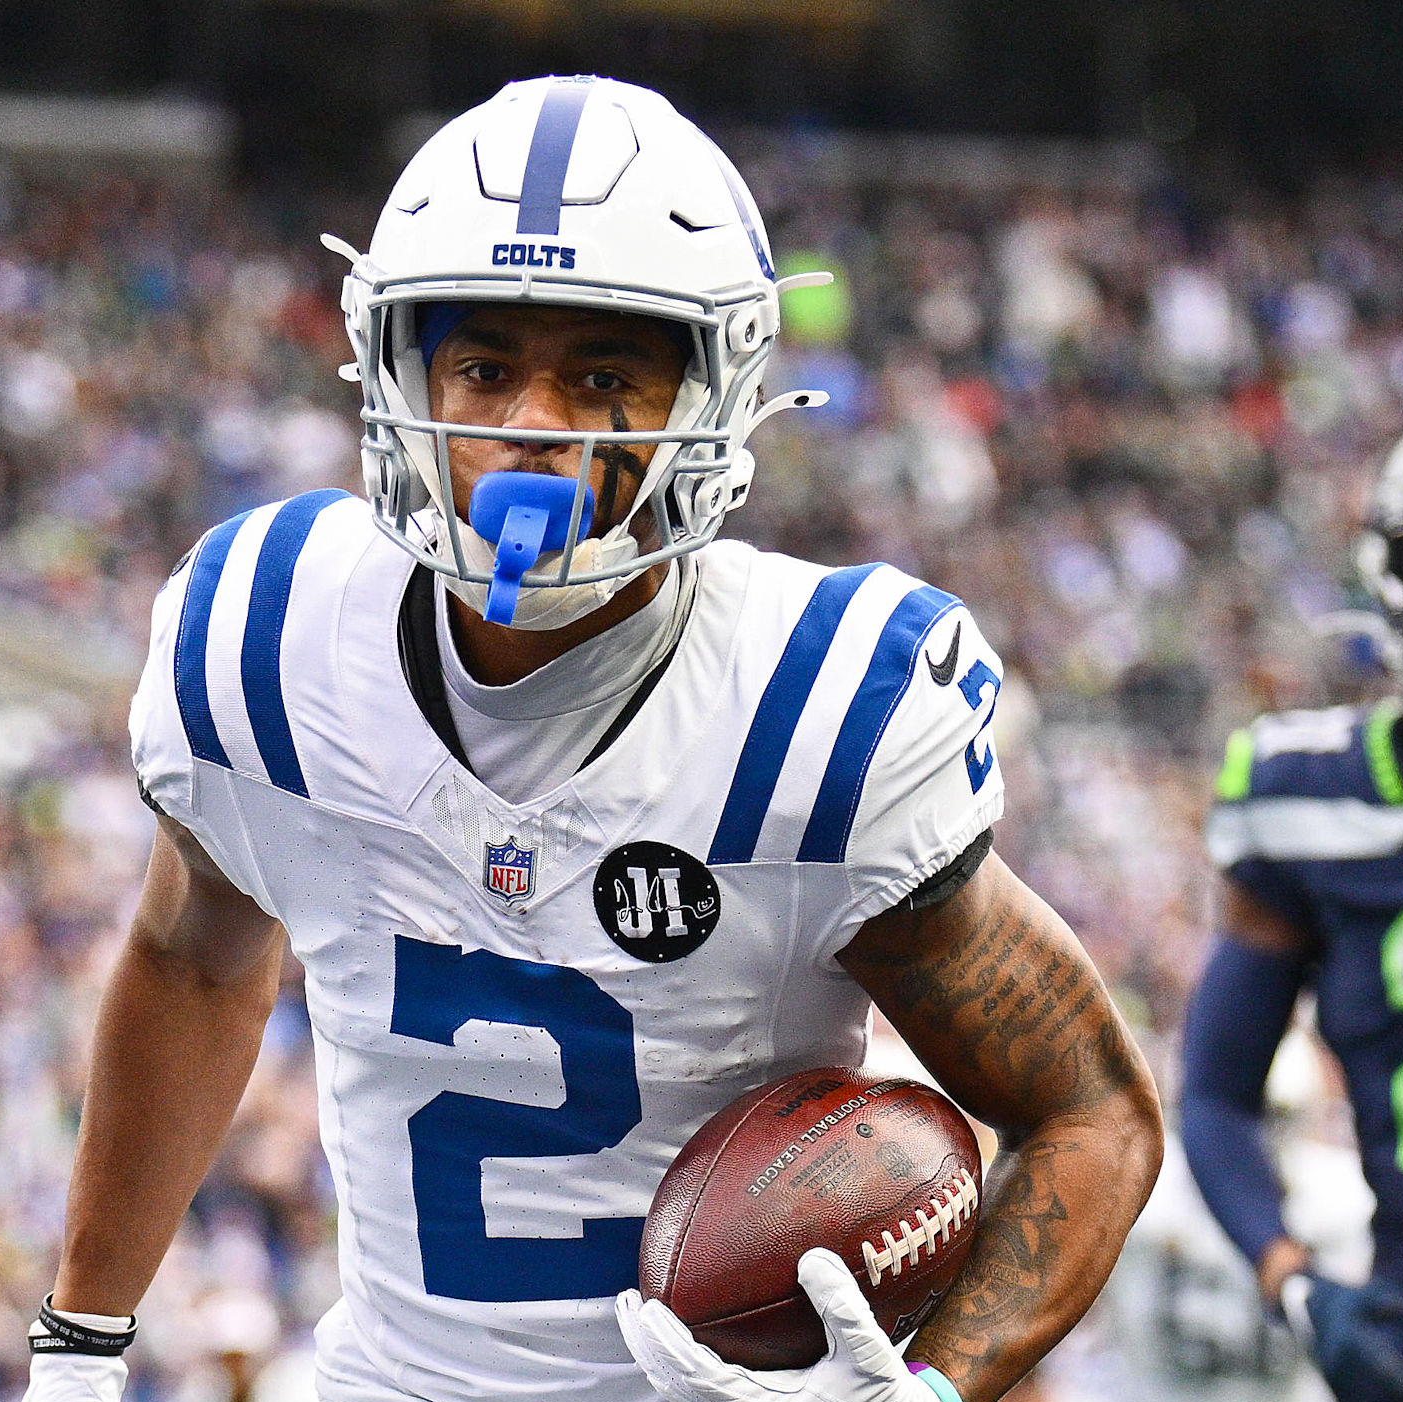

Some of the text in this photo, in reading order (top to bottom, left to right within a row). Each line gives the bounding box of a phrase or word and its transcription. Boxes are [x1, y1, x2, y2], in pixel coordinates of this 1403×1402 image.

[492, 244, 576, 269] COLTS
[491, 866, 528, 894] NFL
[389, 933, 647, 1303] 2
[800, 1094, 868, 1143] FOOTBALL
[748, 1143, 804, 1198] LEAGUE
